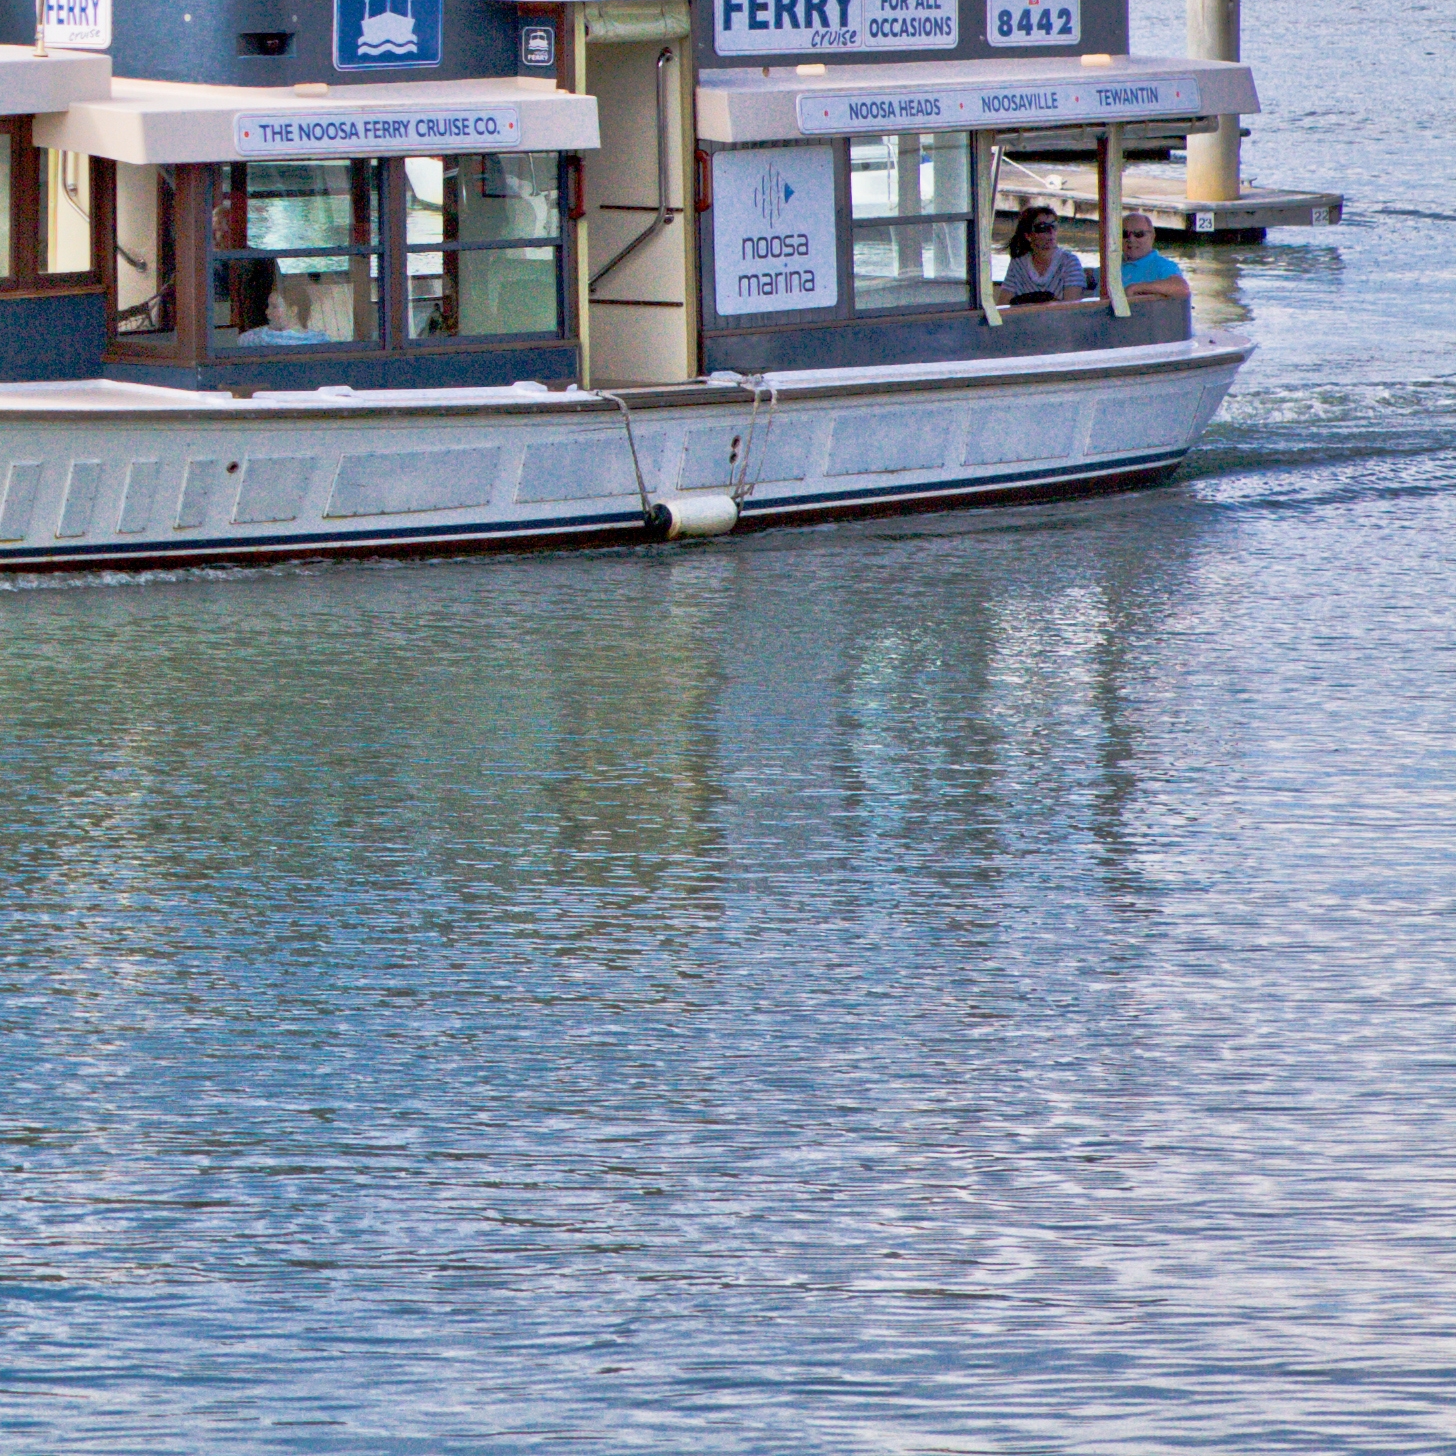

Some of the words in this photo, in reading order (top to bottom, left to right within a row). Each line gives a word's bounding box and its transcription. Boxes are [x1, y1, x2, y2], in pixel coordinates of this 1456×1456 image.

[69, 28, 101, 41] cruise
[869, 16, 952, 38] OCCASIONS
[997, 8, 1073, 37] 8442
[811, 28, 857, 47] cruise
[849, 100, 896, 121] NOOSA
[898, 98, 942, 118] HEADS
[981, 92, 1059, 114] NOOSAVILLE
[1096, 87, 1159, 106] TEWANTIN
[259, 124, 294, 143] THE
[297, 122, 359, 142] NOOSA
[363, 120, 411, 140] FERRY
[414, 117, 471, 138] CRUISE
[473, 116, 501, 136] CO.
[1198, 217, 1213, 229] 23
[1314, 211, 1330, 222] 22
[742, 234, 809, 260] noosa
[738, 263, 815, 297] marina
